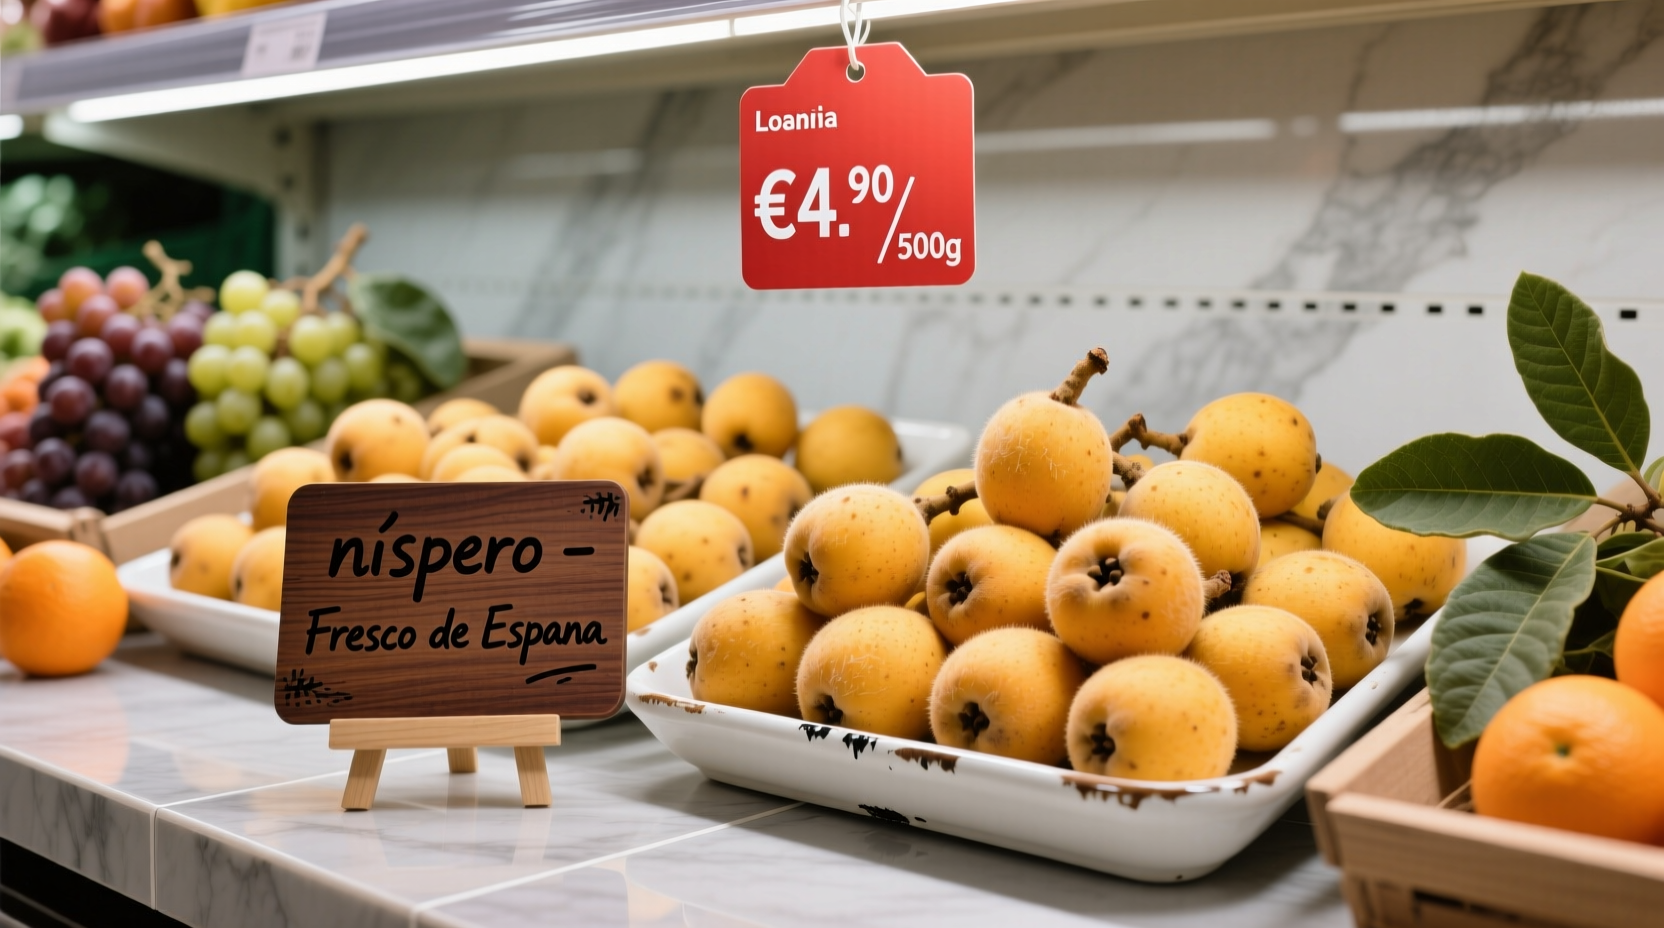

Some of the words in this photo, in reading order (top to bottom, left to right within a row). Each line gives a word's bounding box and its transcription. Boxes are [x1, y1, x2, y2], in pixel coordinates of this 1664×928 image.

[328, 510, 543, 603] níspero
[305, 605, 417, 655] Fresco
[428, 607, 470, 650] de
[481, 603, 608, 666] Espana
